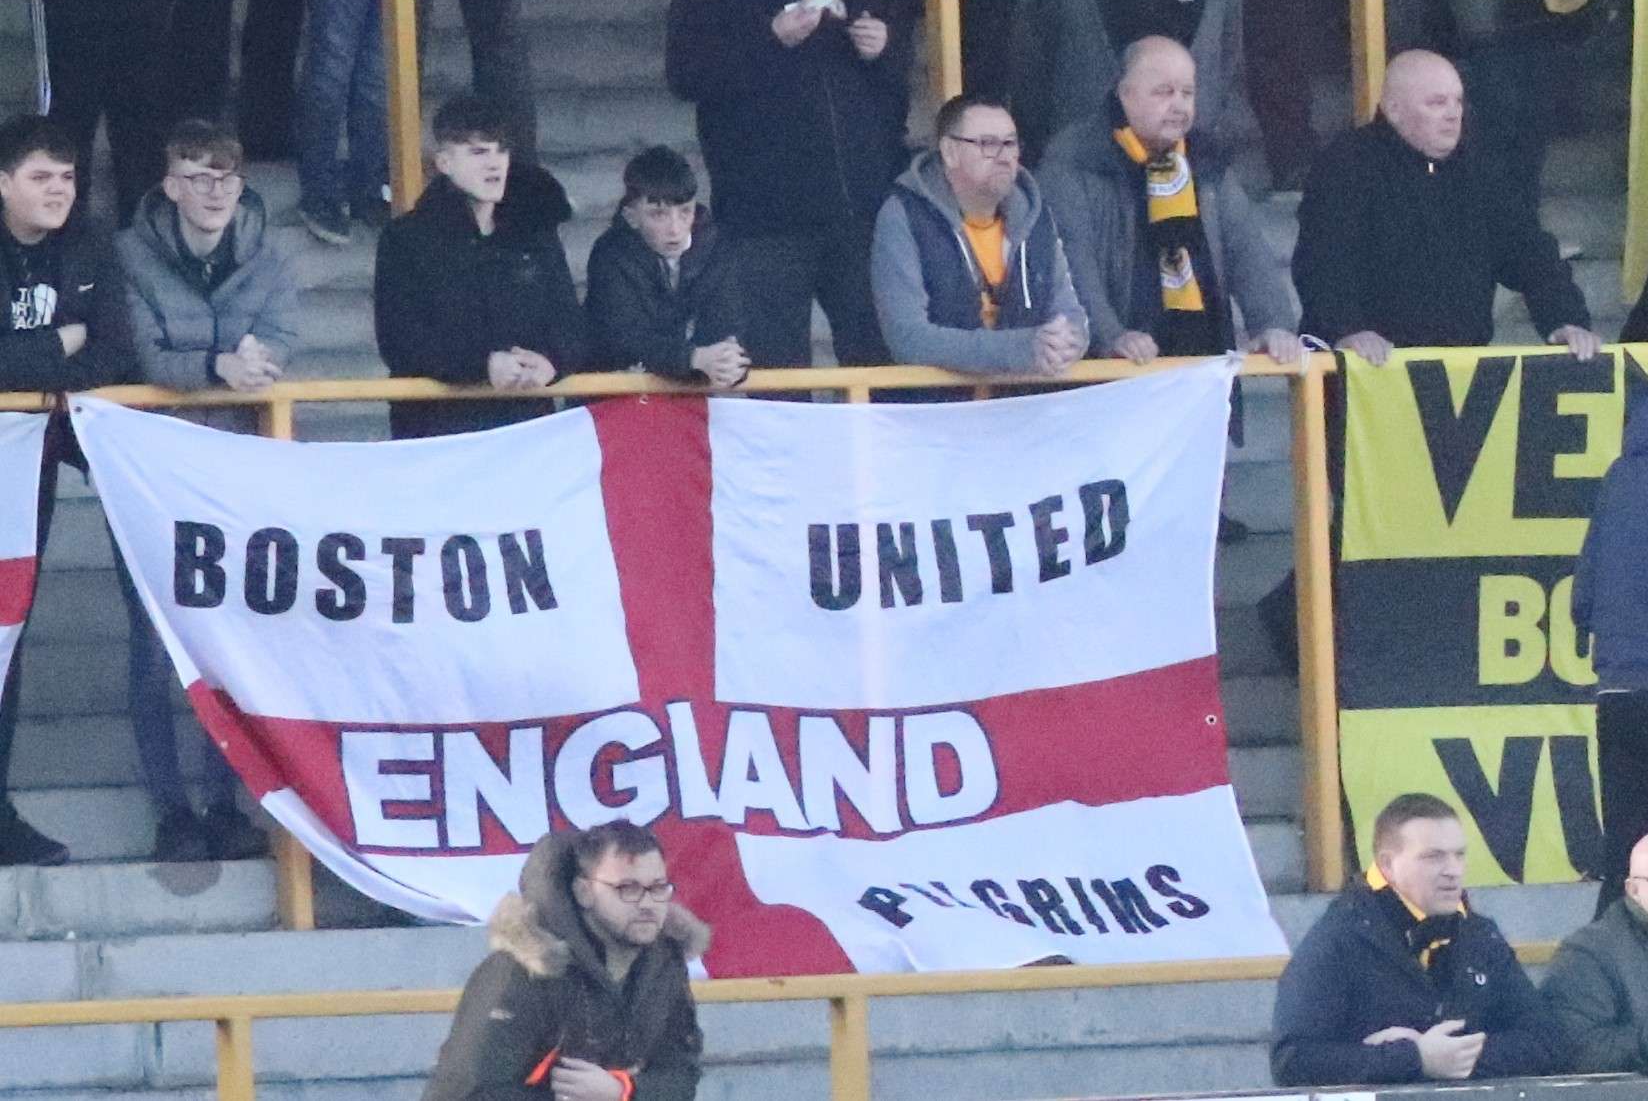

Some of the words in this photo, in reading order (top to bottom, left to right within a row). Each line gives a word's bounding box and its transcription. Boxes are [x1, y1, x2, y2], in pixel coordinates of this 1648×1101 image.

[174, 520, 559, 624] BOSTON
[807, 479, 1131, 611] UNITED
[338, 697, 1002, 852] ENGLAND
